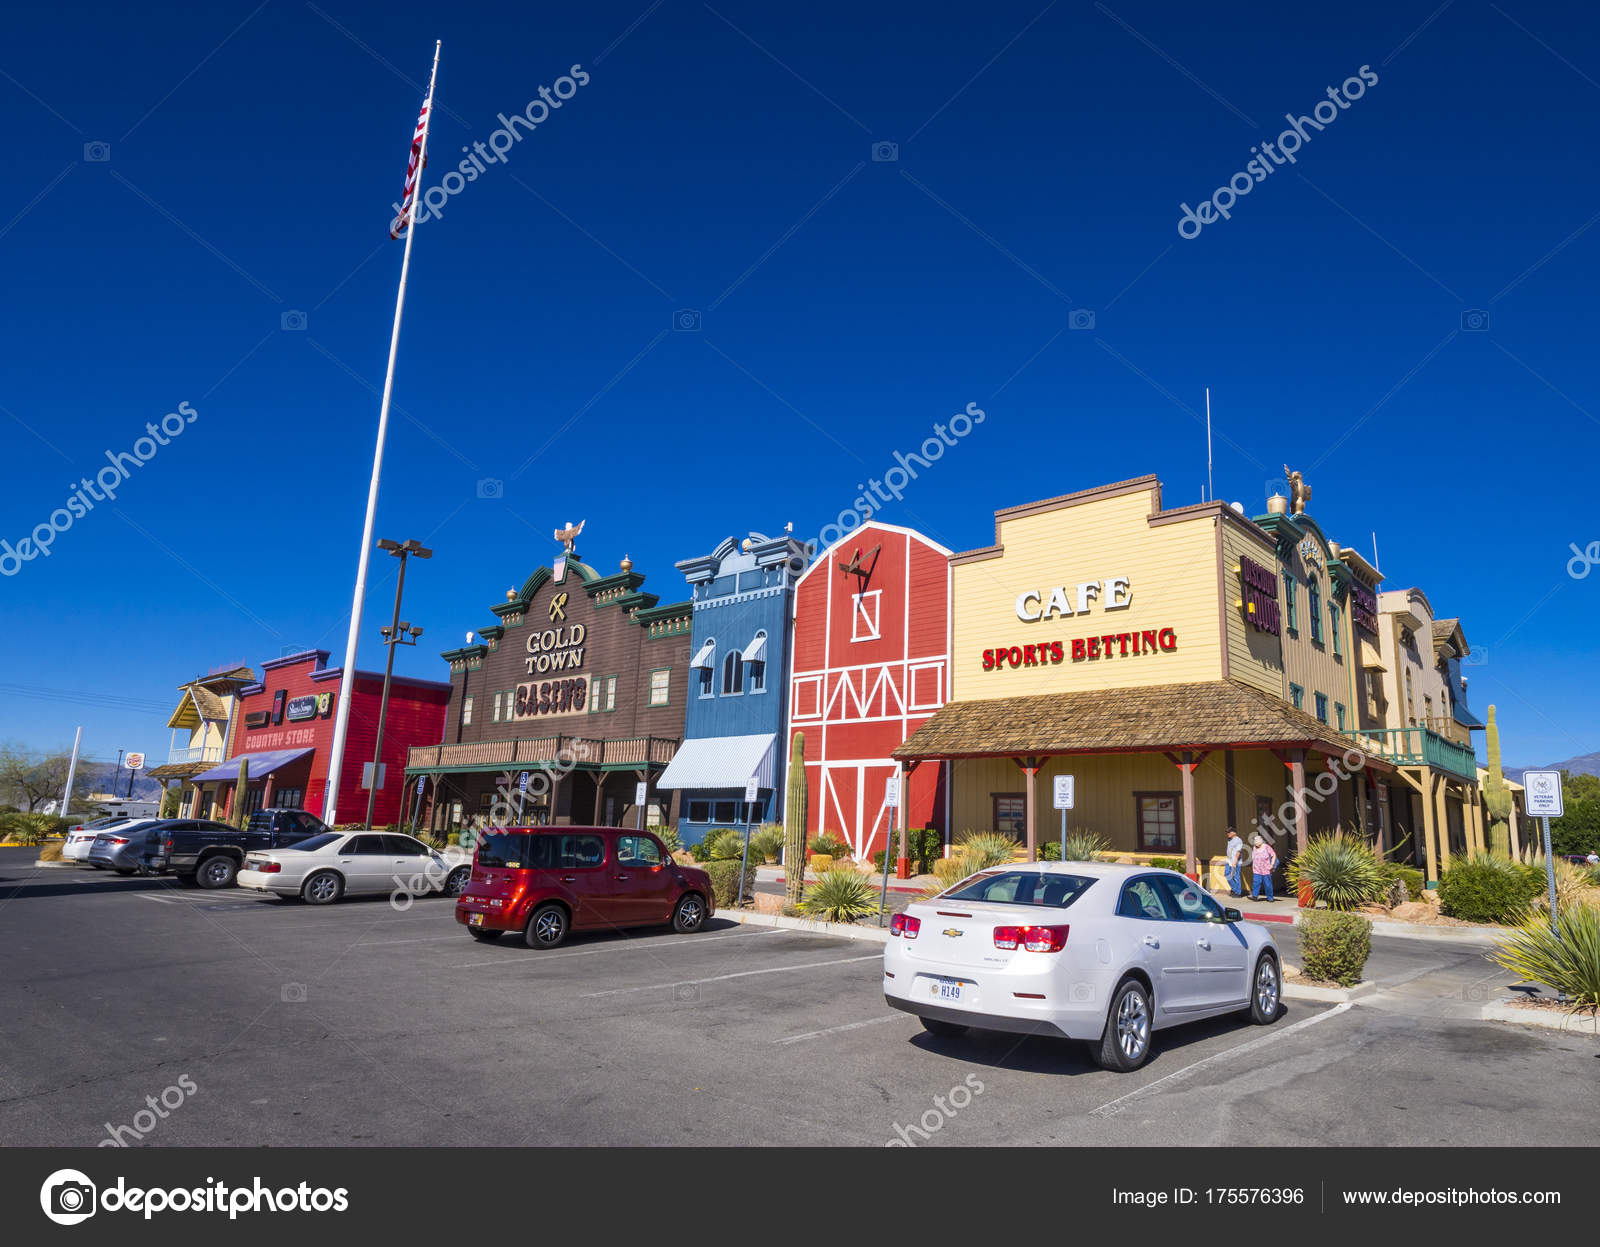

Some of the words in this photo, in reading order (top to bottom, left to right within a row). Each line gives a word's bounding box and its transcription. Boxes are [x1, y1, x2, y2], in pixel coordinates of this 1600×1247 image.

[1015, 576, 1133, 623] CAFE
[526, 624, 586, 654] GOLD
[982, 641, 1064, 671] SPORTS
[1071, 627, 1177, 663] BETTING
[525, 648, 584, 675] TOWN
[515, 677, 587, 717] CASINO
[245, 731, 284, 749] COUNTRY
[285, 728, 316, 745] STORE
[941, 985, 960, 999] H149
